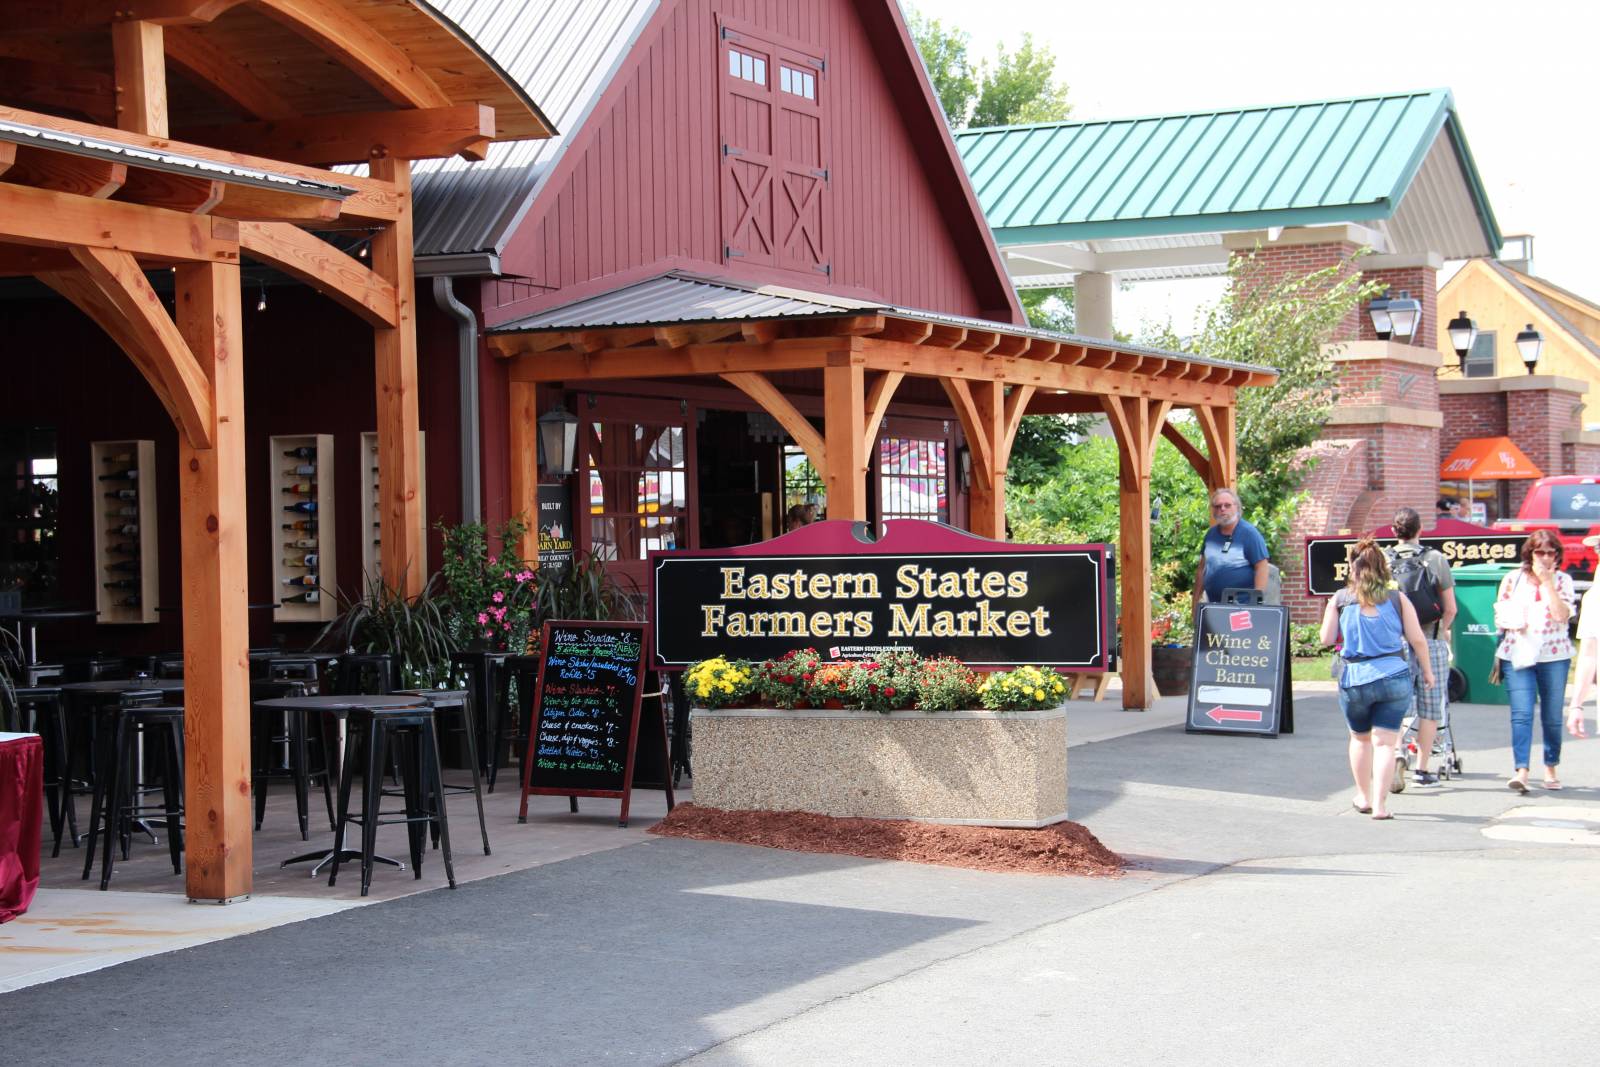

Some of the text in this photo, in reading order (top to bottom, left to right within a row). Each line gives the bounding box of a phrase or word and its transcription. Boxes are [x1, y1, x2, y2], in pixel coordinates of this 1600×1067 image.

[541, 502, 562, 511] BUILT BY
[538, 541, 553, 550] ARN
[1442, 541, 1517, 560] States
[720, 564, 1029, 600] Eastern States
[700, 600, 1052, 638] Farmers Market
[1206, 633, 1272, 650] Wine &
[1205, 650, 1269, 667] Cheese
[1215, 668, 1256, 684] Barn
